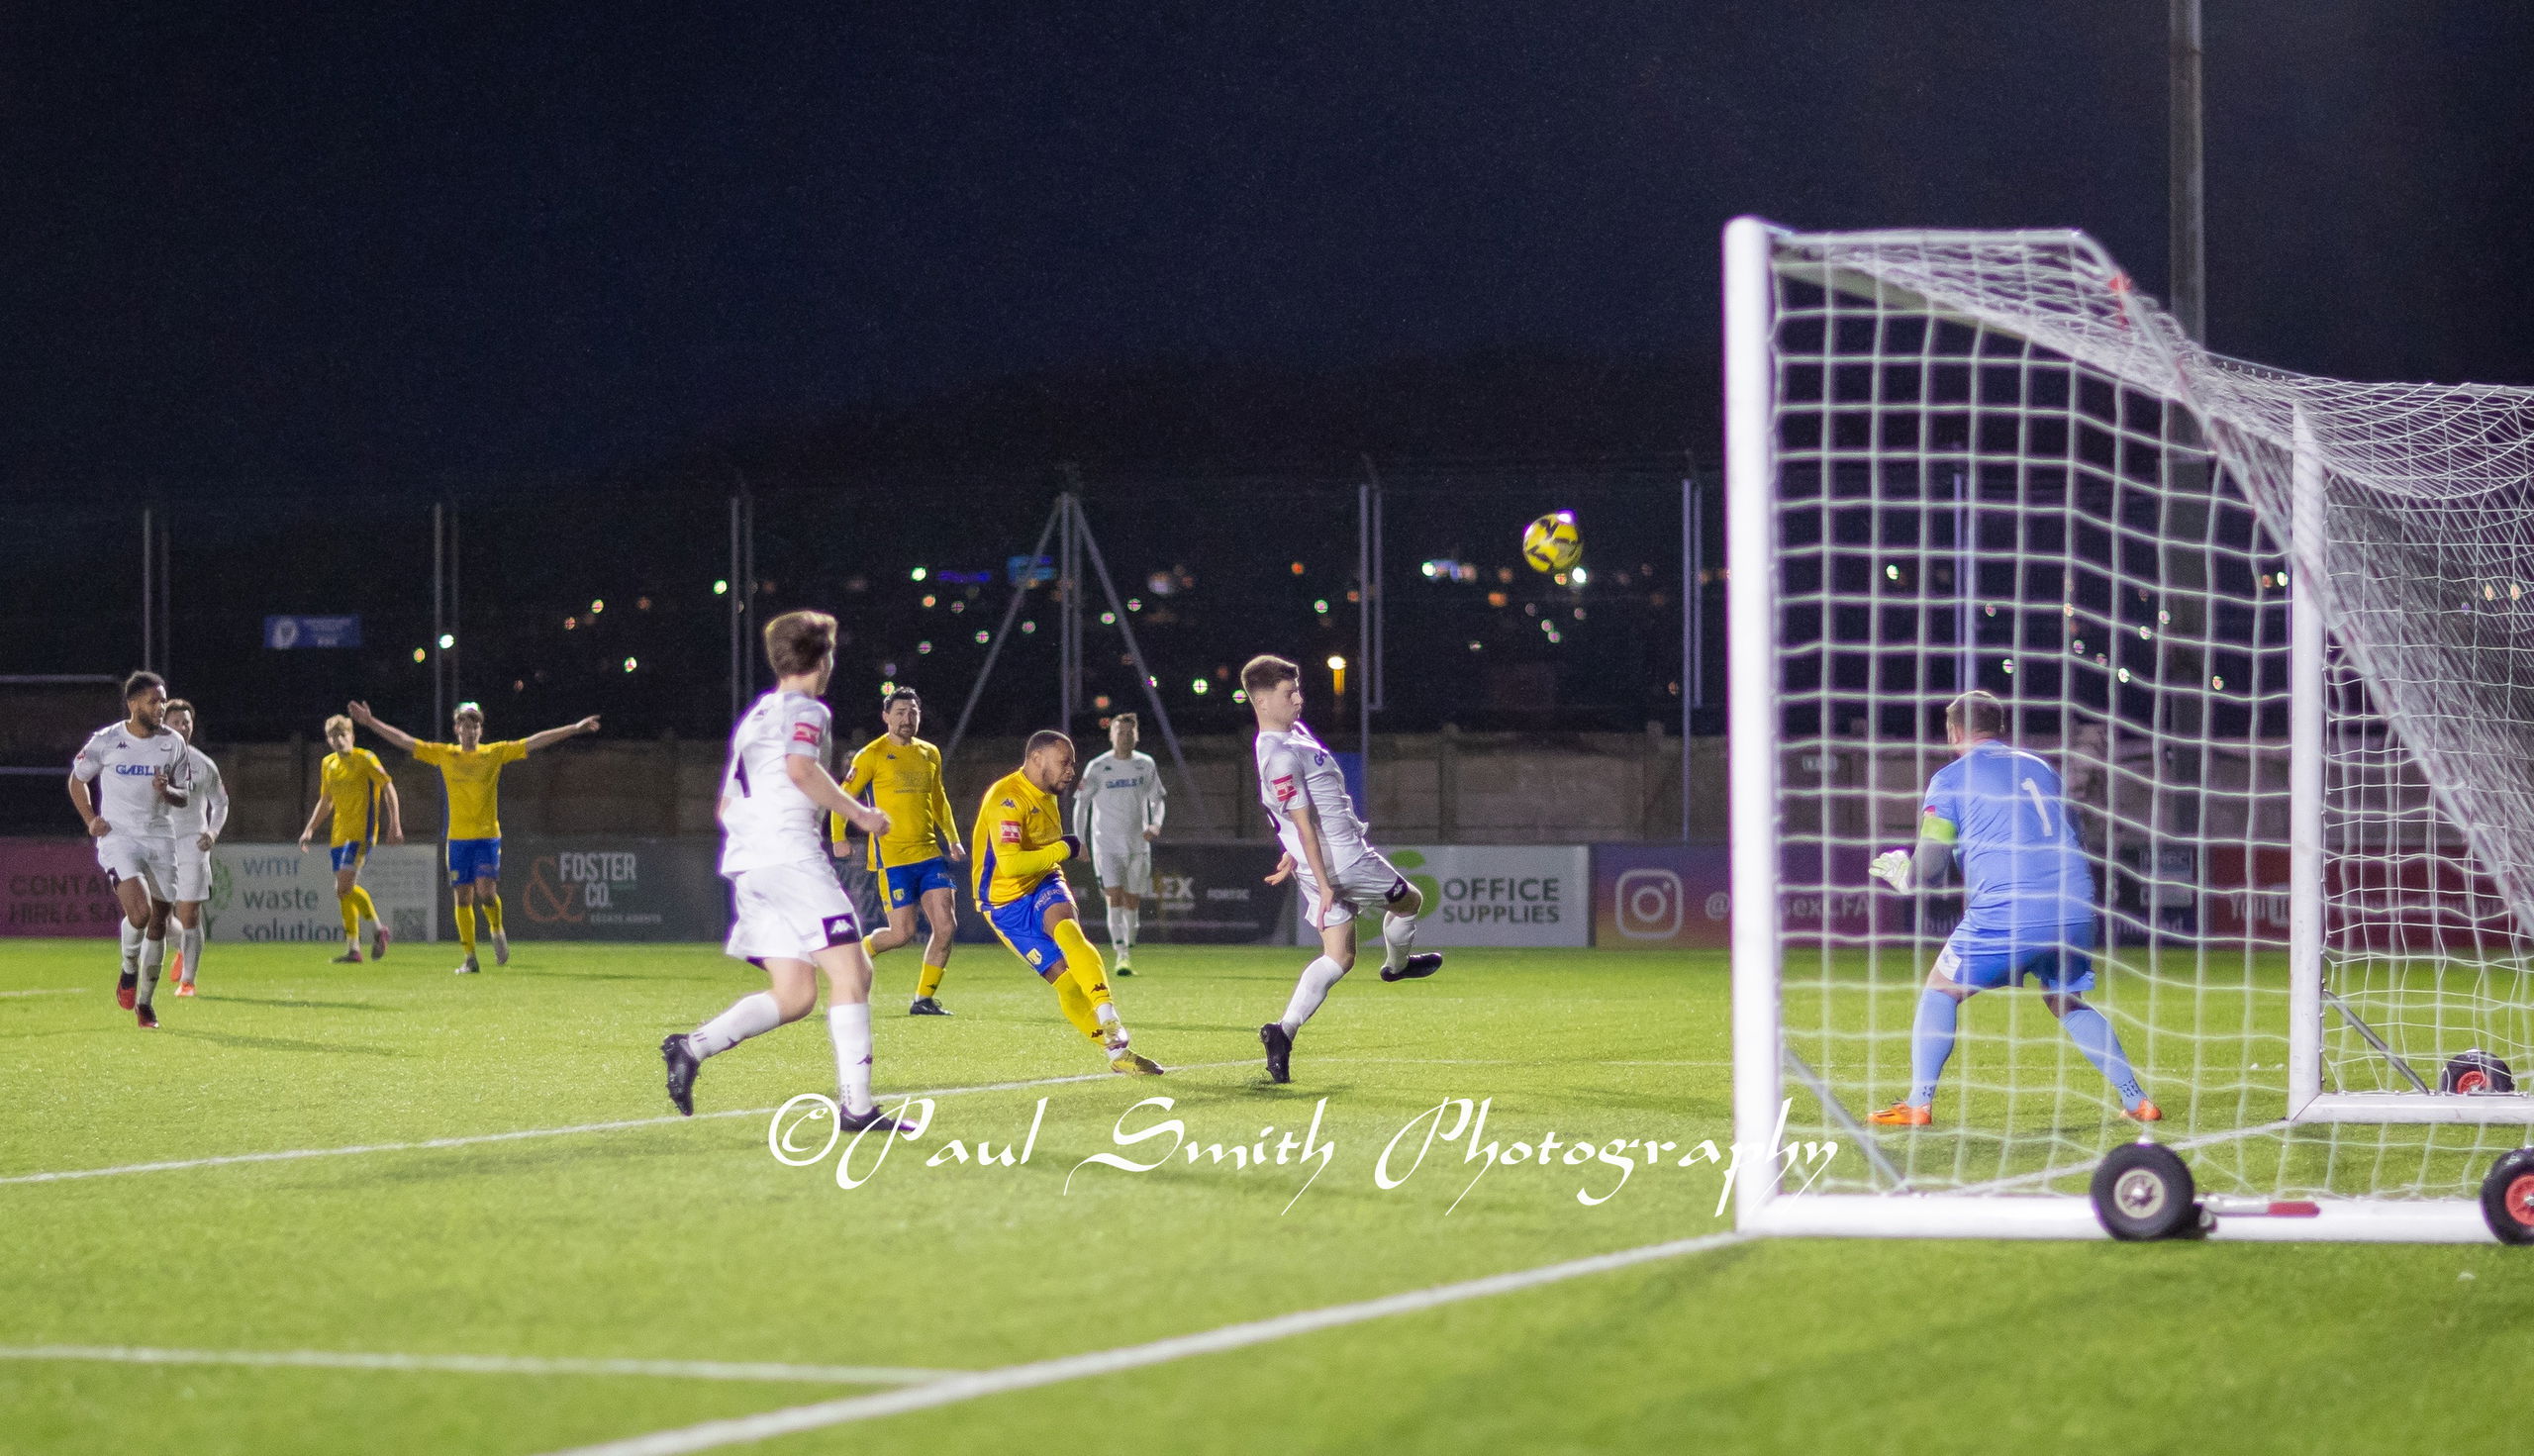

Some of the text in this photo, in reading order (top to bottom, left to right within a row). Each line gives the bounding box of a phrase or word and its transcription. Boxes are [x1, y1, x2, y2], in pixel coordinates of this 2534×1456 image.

[2021, 777, 2053, 836] 1
[243, 857, 299, 877] wmr
[559, 852, 635, 881] FOSTER
[243, 889, 319, 911] waste
[1443, 877, 1560, 902] OFFICE
[1442, 905, 1560, 923] SUPPLIES
[243, 917, 344, 940] solution
